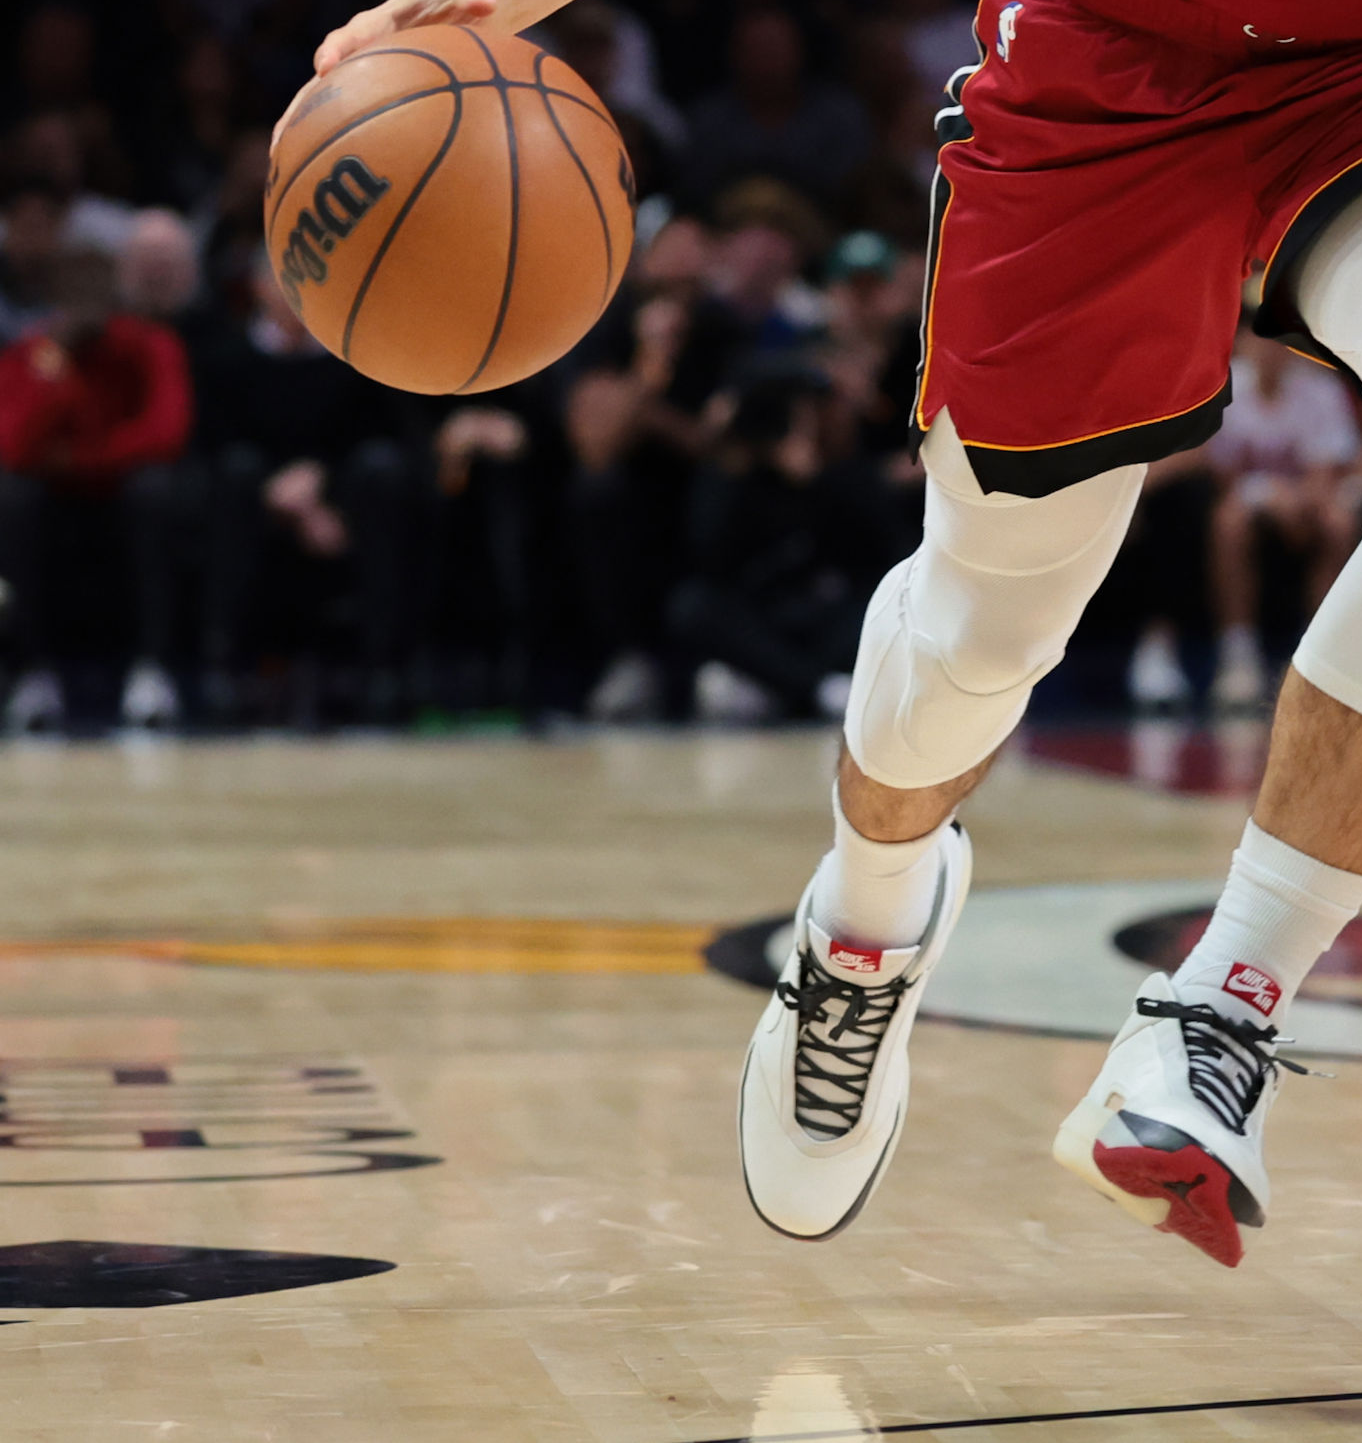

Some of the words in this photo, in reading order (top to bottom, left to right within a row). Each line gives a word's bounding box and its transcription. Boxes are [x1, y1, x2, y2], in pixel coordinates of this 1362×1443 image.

[280, 155, 393, 312] Wils
[1239, 967, 1271, 988] NIKE
[1252, 993, 1273, 1011] AIR
